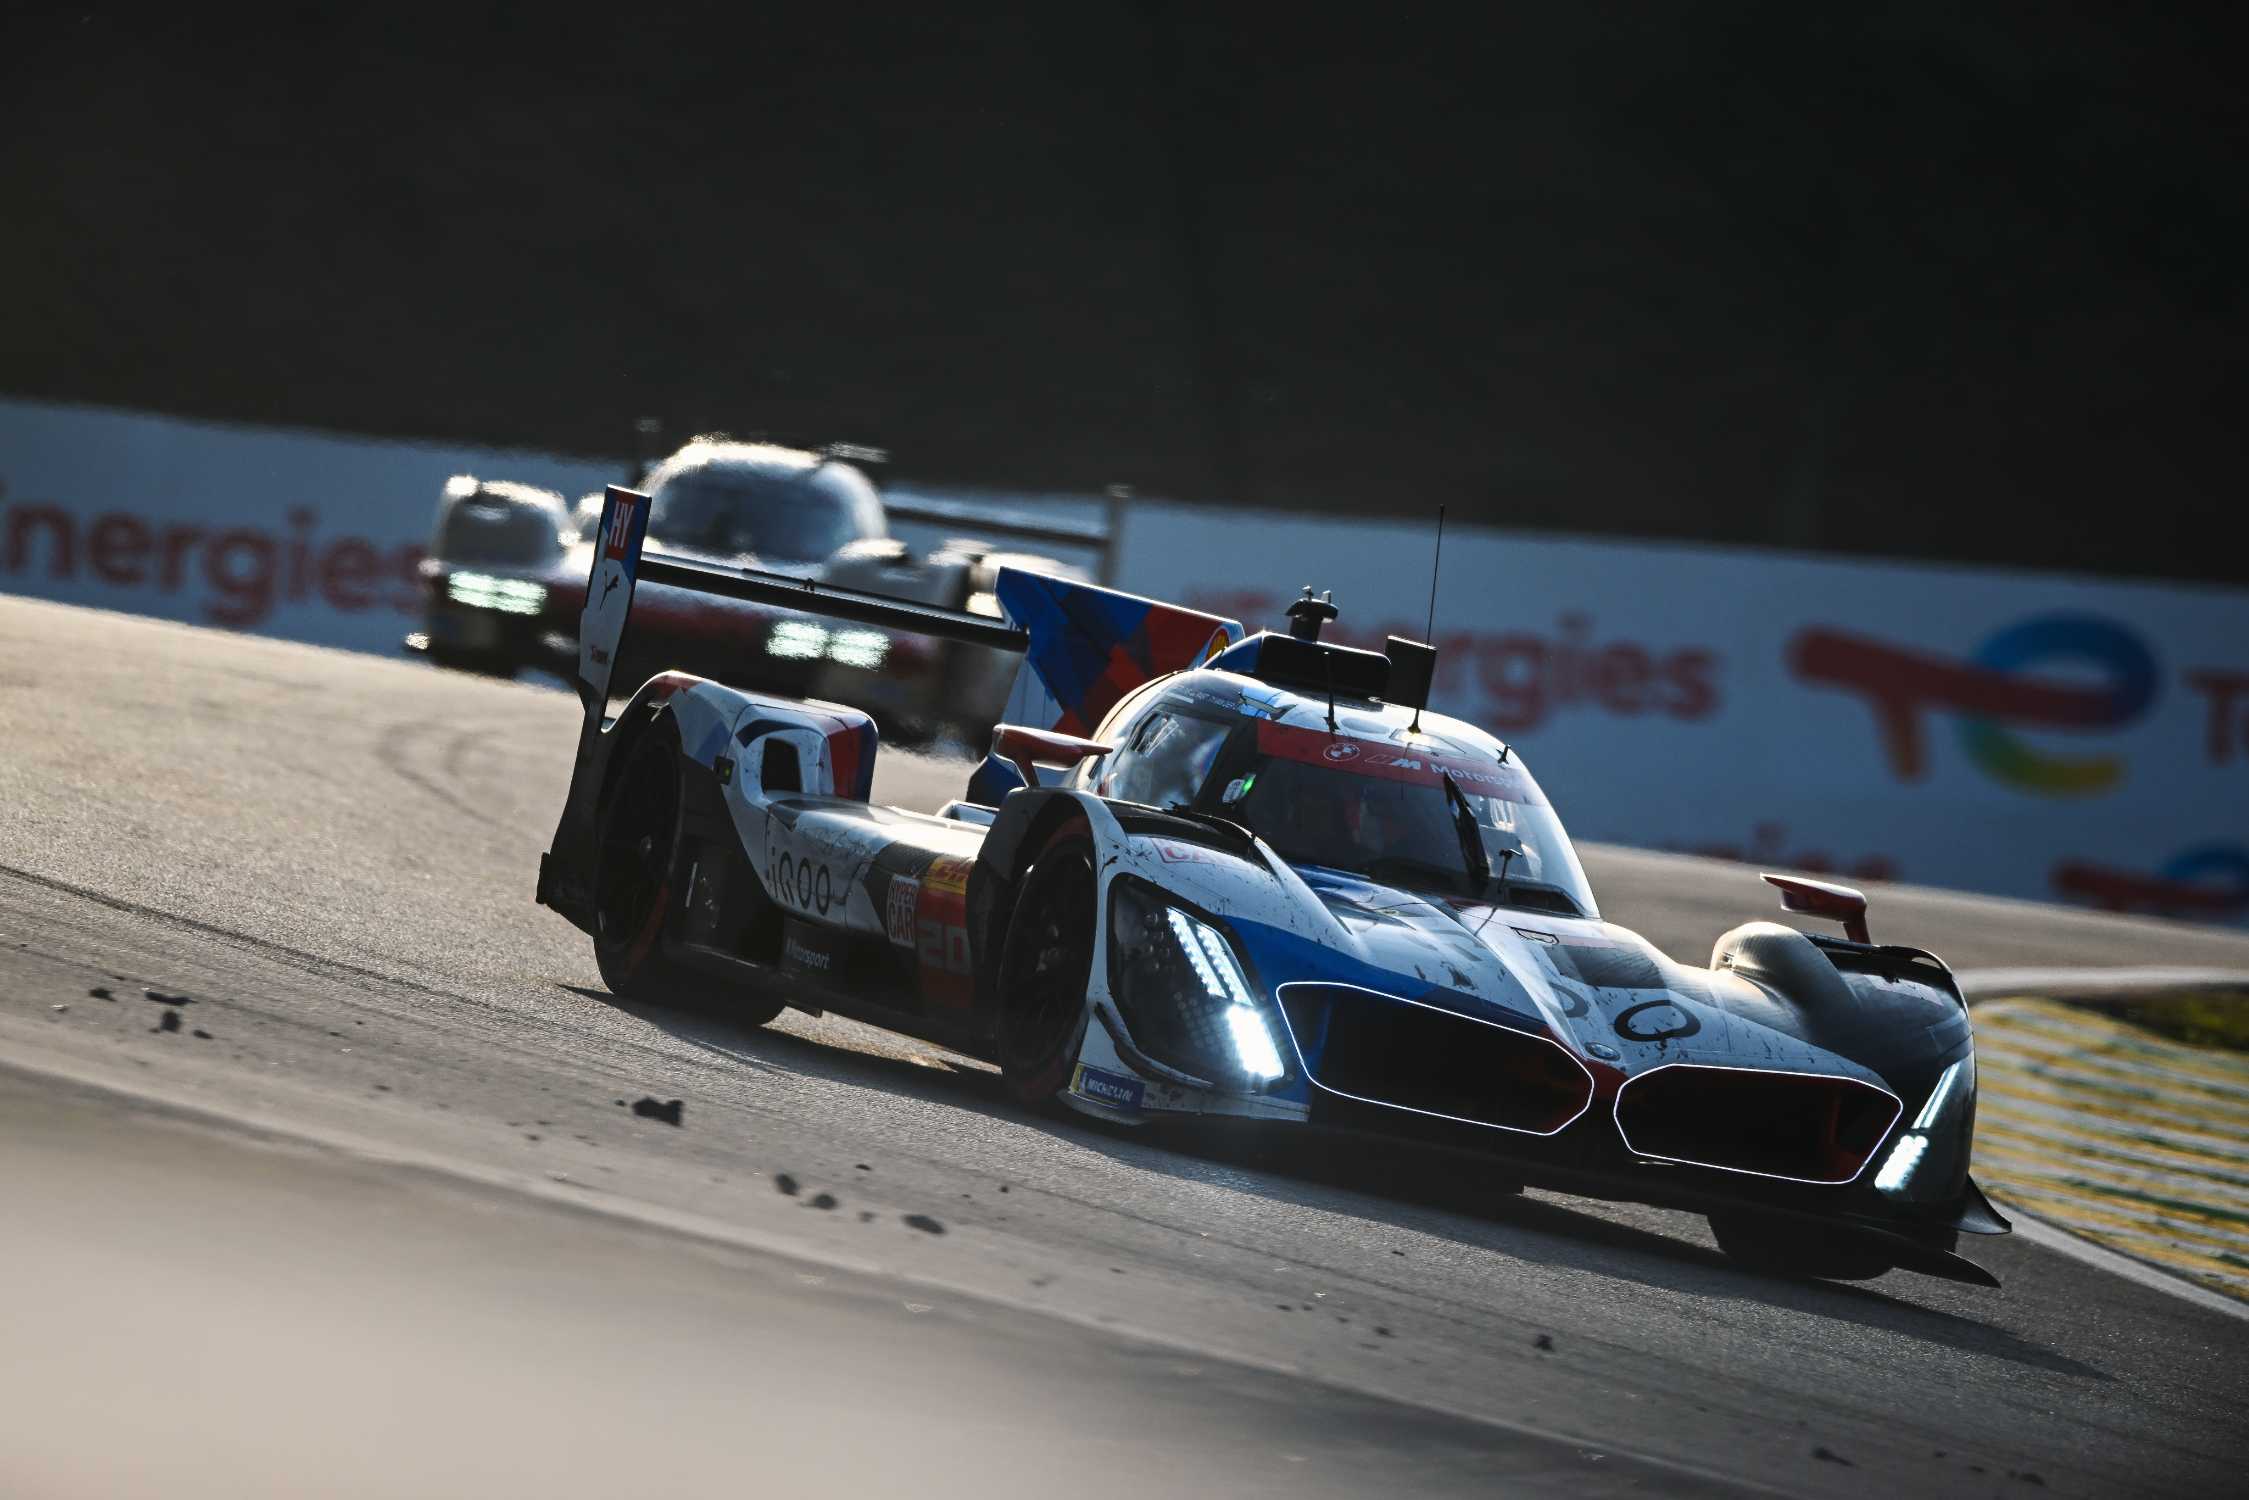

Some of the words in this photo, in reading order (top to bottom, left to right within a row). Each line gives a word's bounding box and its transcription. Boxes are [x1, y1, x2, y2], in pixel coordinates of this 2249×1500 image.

[0, 480, 430, 627] nergies
[609, 500, 635, 549] HY
[2183, 667, 2249, 768] T
[1087, 1078, 1135, 1103] MICHELIN
